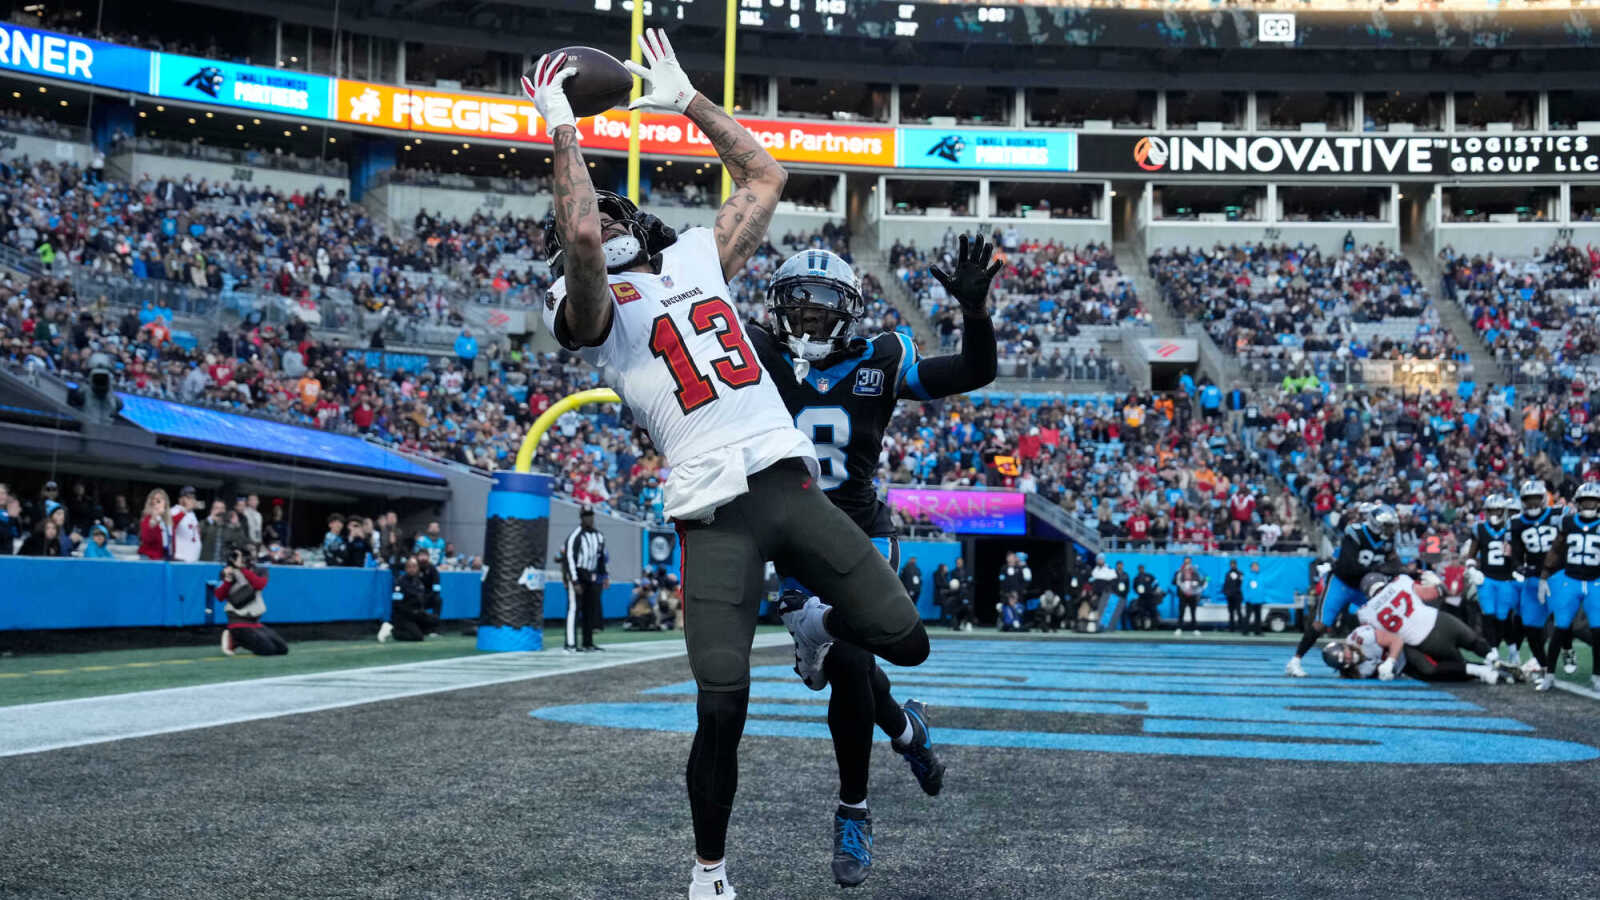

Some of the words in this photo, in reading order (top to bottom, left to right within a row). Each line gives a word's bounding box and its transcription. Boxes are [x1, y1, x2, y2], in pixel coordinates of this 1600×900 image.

[594, 116, 682, 143] Reverse
[790, 128, 882, 155] Partners
[1451, 136, 1589, 153] LOGISTICS
[1451, 156, 1540, 172] GROUP
[1555, 155, 1600, 172] LLC
[660, 287, 703, 307] BUCCANEERS
[649, 296, 763, 416] 13
[858, 369, 882, 386] 30
[794, 406, 851, 492] 8
[1426, 536, 1440, 553] 2
[1487, 540, 1504, 566] 2
[1566, 533, 1600, 566] 25
[1377, 590, 1414, 633] 67
